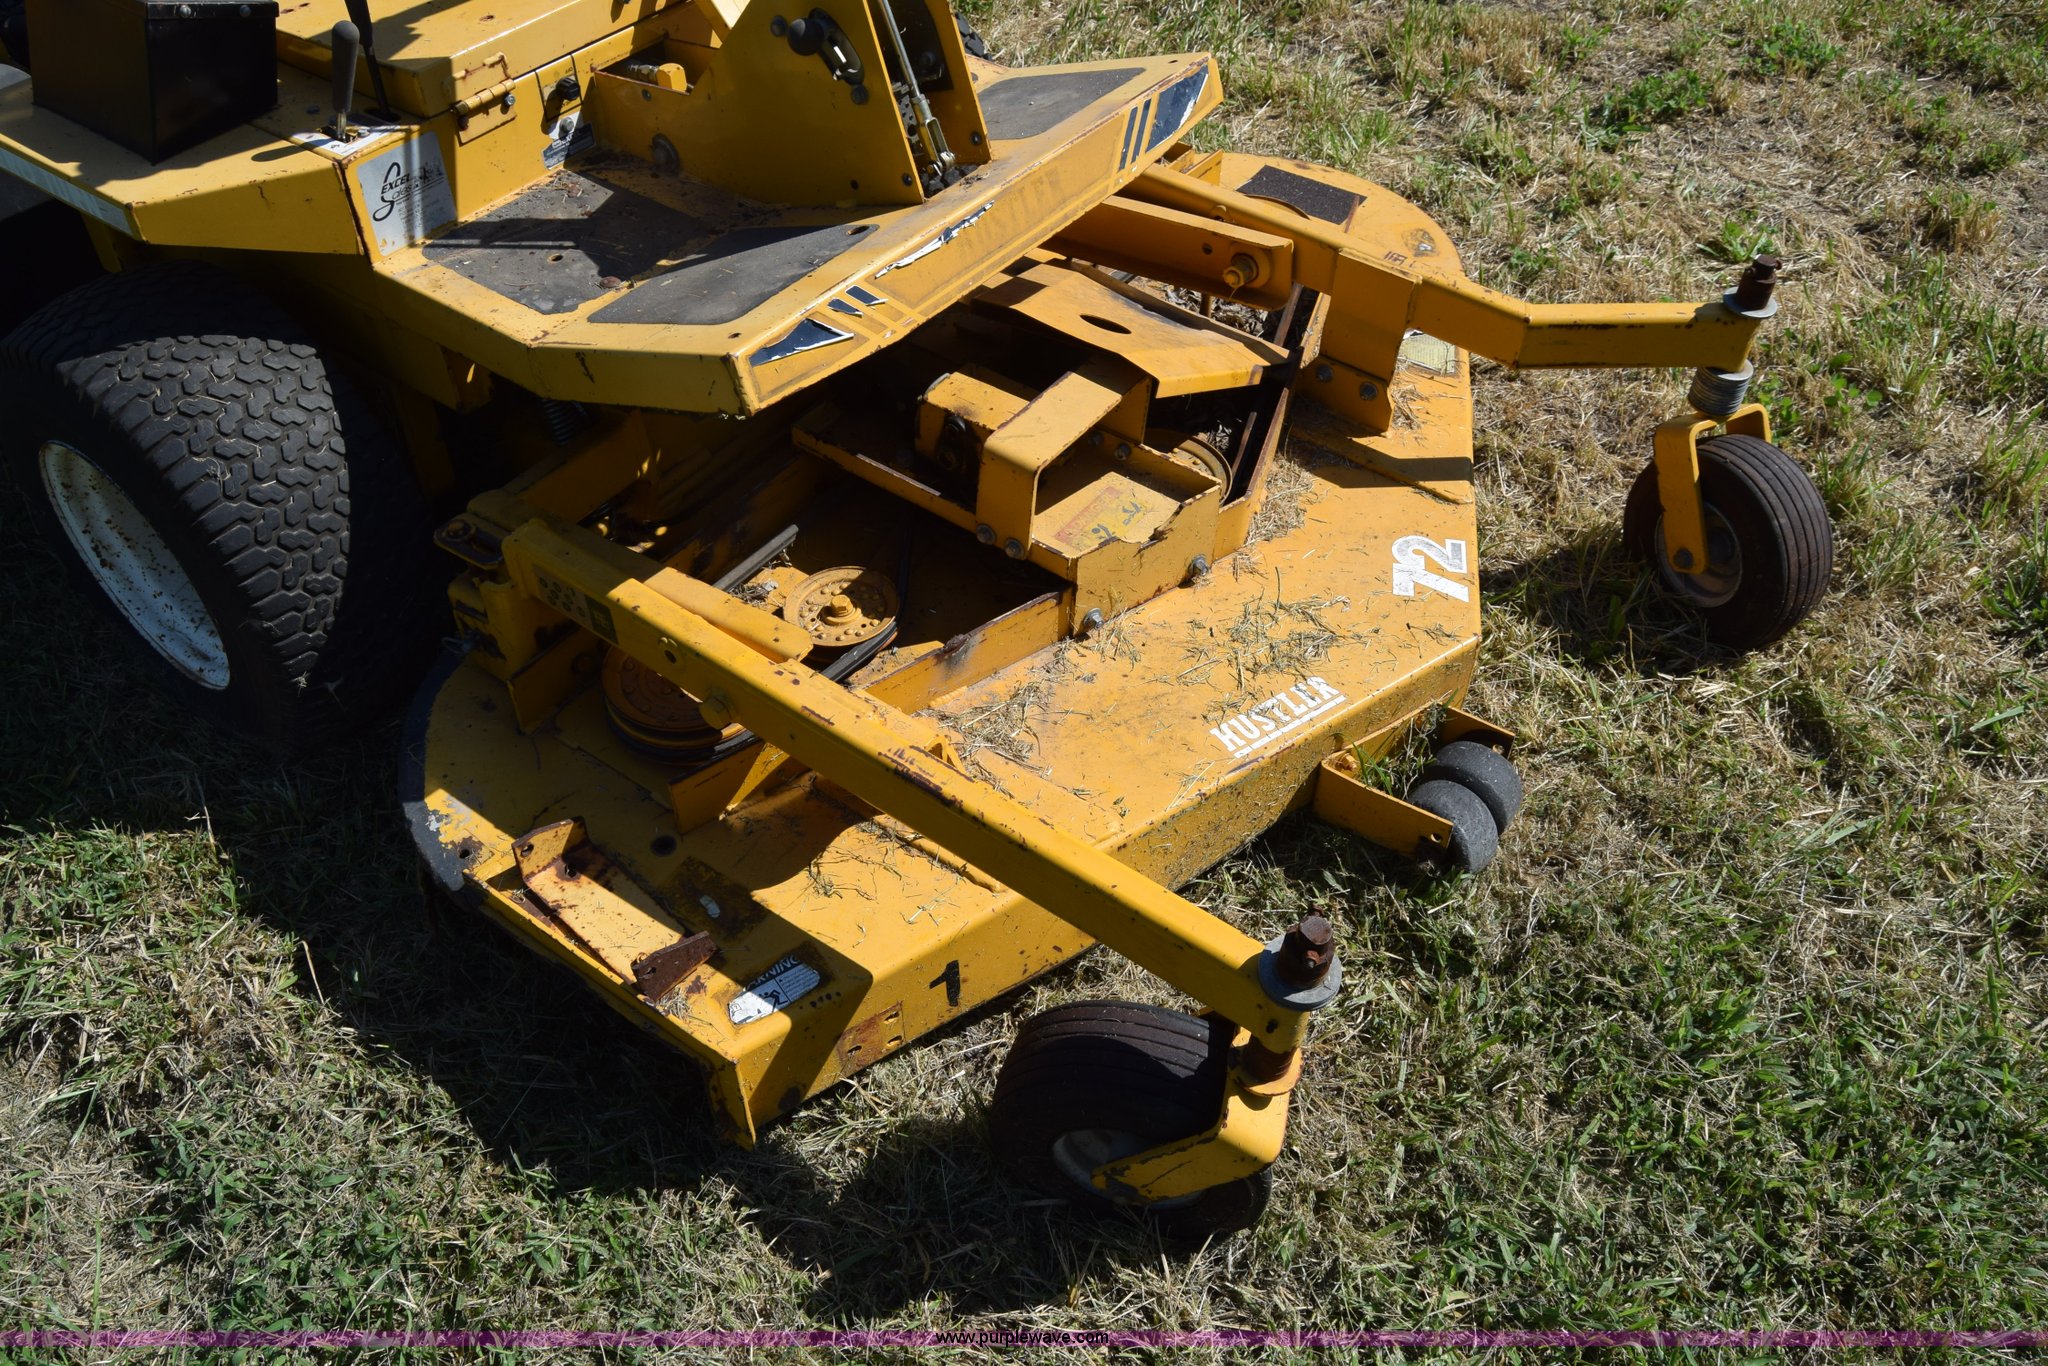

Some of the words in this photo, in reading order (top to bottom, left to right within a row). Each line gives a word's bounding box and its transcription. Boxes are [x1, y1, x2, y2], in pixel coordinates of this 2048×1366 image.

[381, 172, 412, 194] EXCEL
[1391, 535, 1470, 603] 72
[1209, 676, 1341, 753] HUSTLER
[929, 959, 961, 1007] 1
